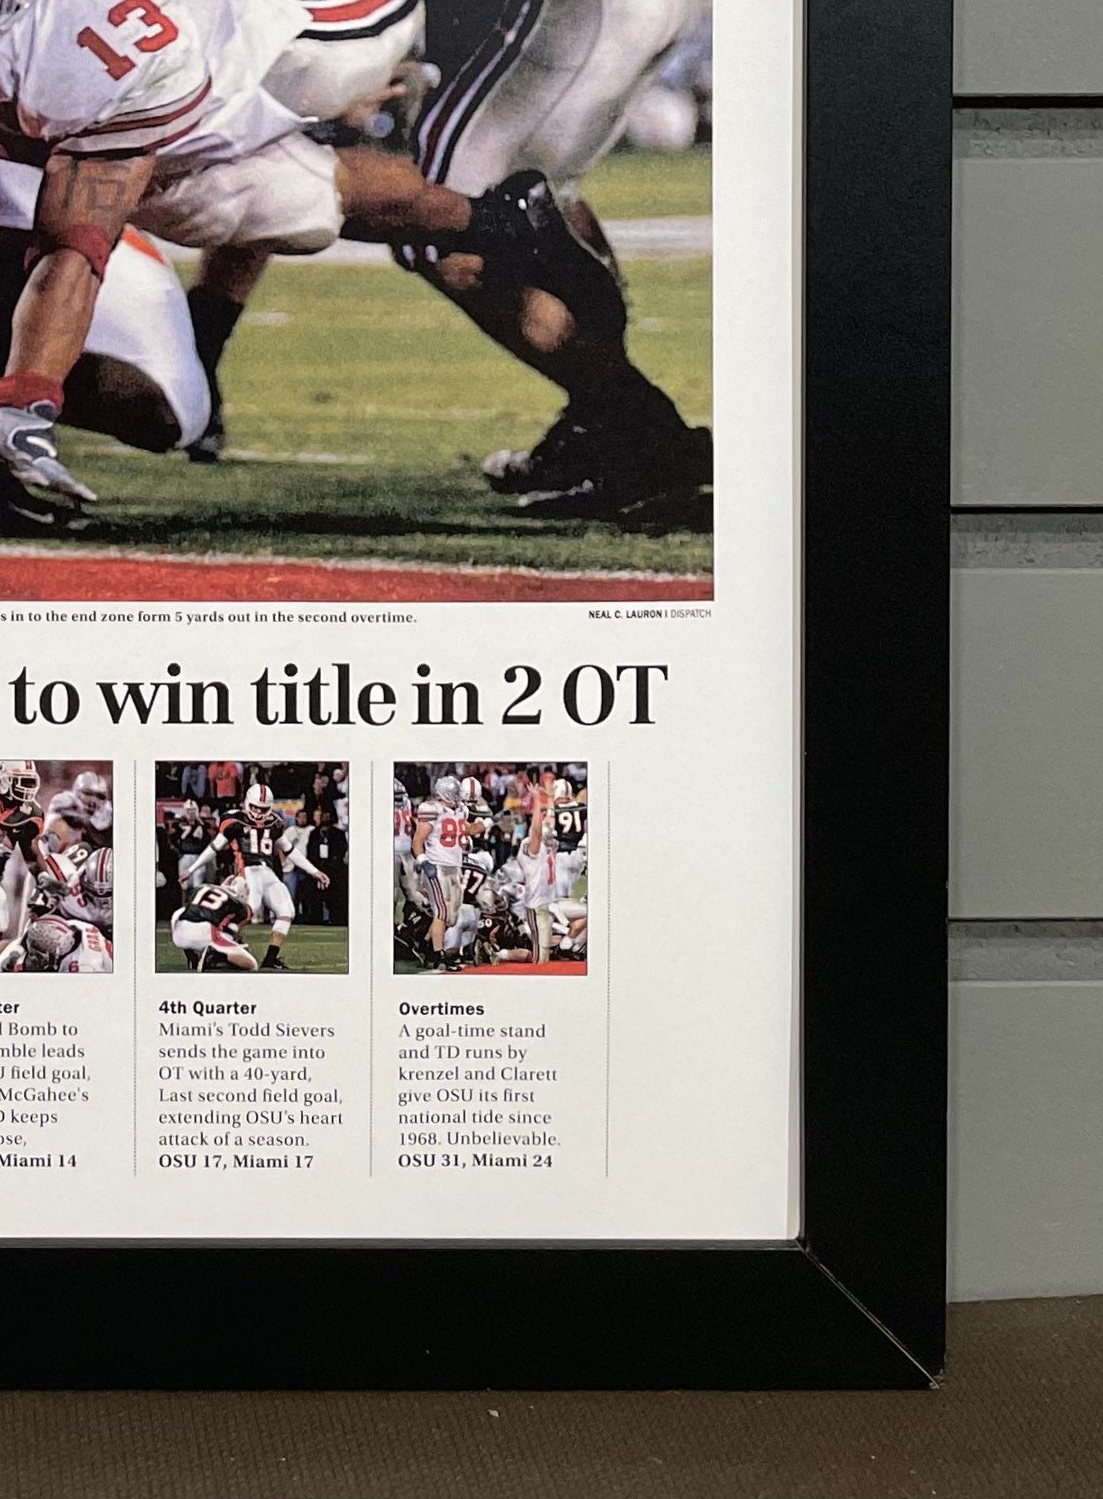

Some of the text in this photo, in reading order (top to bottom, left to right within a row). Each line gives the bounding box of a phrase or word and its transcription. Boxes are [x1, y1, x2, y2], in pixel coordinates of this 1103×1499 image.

[10, 610, 24, 622] in
[28, 612, 42, 622] to
[45, 610, 68, 622] the
[71, 610, 97, 622] end
[100, 613, 134, 623] zone
[138, 610, 171, 623] form
[175, 611, 183, 623] 5
[186, 610, 225, 626] yards
[227, 613, 251, 623] out
[254, 611, 268, 623] in
[272, 610, 295, 623] the
[297, 611, 347, 623] second
[350, 611, 417, 623] overtime.
[588, 609, 612, 620] NEAL
[625, 609, 663, 619] LAURON
[670, 609, 712, 619] DISPATCH
[8, 665, 81, 725] to
[95, 662, 235, 725] win
[249, 662, 397, 727] title
[411, 663, 484, 726] in
[501, 665, 542, 725] 2
[562, 664, 669, 727] OT
[249, 828, 273, 856] 16
[191, 884, 230, 912] 13
[158, 1000, 257, 1017] 4th Quarter
[399, 1001, 485, 1016] Overtimes
[8, 1021, 57, 1036] Bomb
[62, 1024, 78, 1036] to
[159, 1021, 335, 1038] Miami's Todd Sievers
[398, 1022, 546, 1042] A goal-time stand
[41, 1043, 85, 1058] leads
[158, 1043, 326, 1063] sends the game into
[398, 1065, 557, 1082] krenzel and Clarett
[158, 1109, 343, 1129] extending OSU's heart
[398, 1109, 466, 1125] national
[508, 1113, 552, 1125] since
[447, 1131, 561, 1146] Unbelievable.
[59, 1154, 77, 1168] 14
[158, 1153, 314, 1170] OSU 17, Miami 17
[398, 1153, 553, 1169] OSU 31, Miami 24
